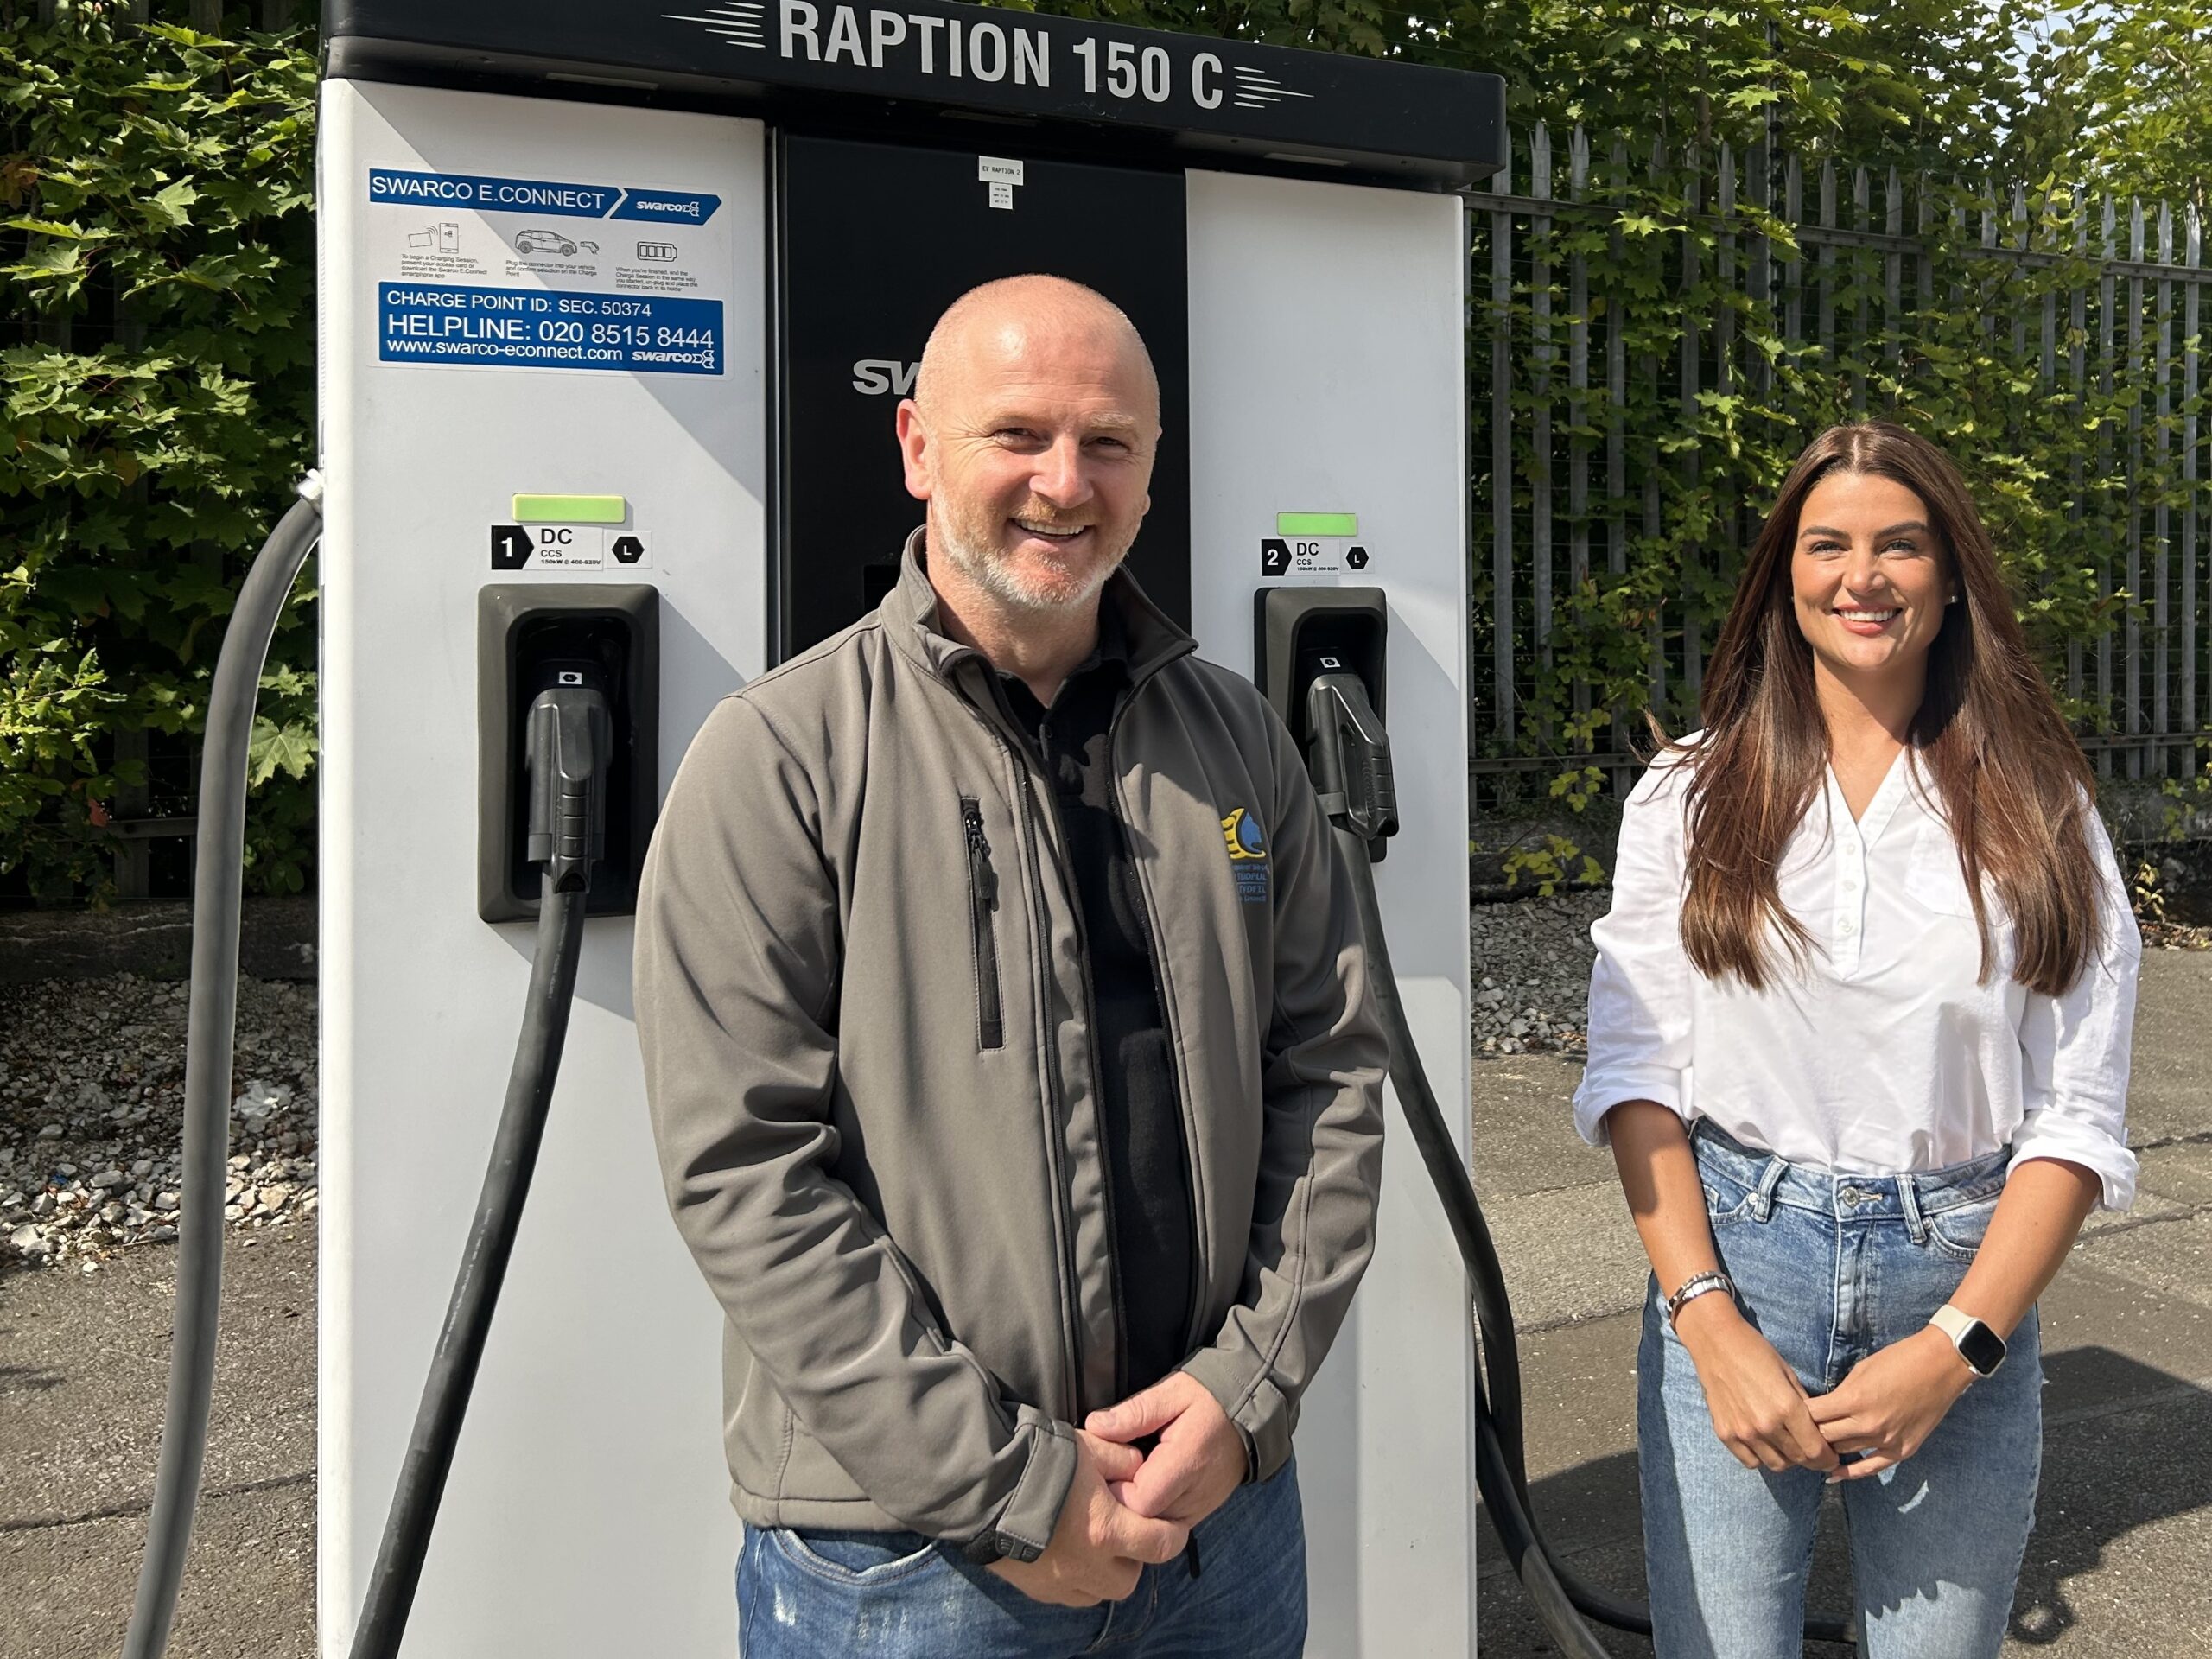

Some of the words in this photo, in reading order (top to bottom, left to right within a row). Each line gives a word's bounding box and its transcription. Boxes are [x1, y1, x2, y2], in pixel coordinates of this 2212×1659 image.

[779, 0, 1050, 88] RAPTION
[1072, 37, 1170, 104] 150
[1192, 52, 1223, 110] C
[992, 166, 1014, 175] RAPTION
[372, 176, 473, 200] SWARCO
[479, 184, 605, 209] E.CONNECT
[636, 201, 683, 212] swarco
[387, 290, 466, 308] CHARGE
[472, 295, 526, 311] POINT
[531, 298, 553, 312] ID:
[559, 299, 597, 315] SEC.
[602, 302, 652, 317] 50374
[389, 314, 531, 340] HELPLINE:
[539, 321, 584, 343] 020
[591, 324, 650, 346] 8515
[657, 327, 714, 349] 8444
[387, 340, 623, 360] www.swarco-econnect.com
[632, 351, 692, 363] swarco
[541, 528, 572, 545] DC
[501, 537, 512, 557] 1
[623, 545, 632, 556] L
[1297, 542, 1319, 556] DC
[1267, 548, 1279, 566] 2
[1354, 554, 1360, 563] L
